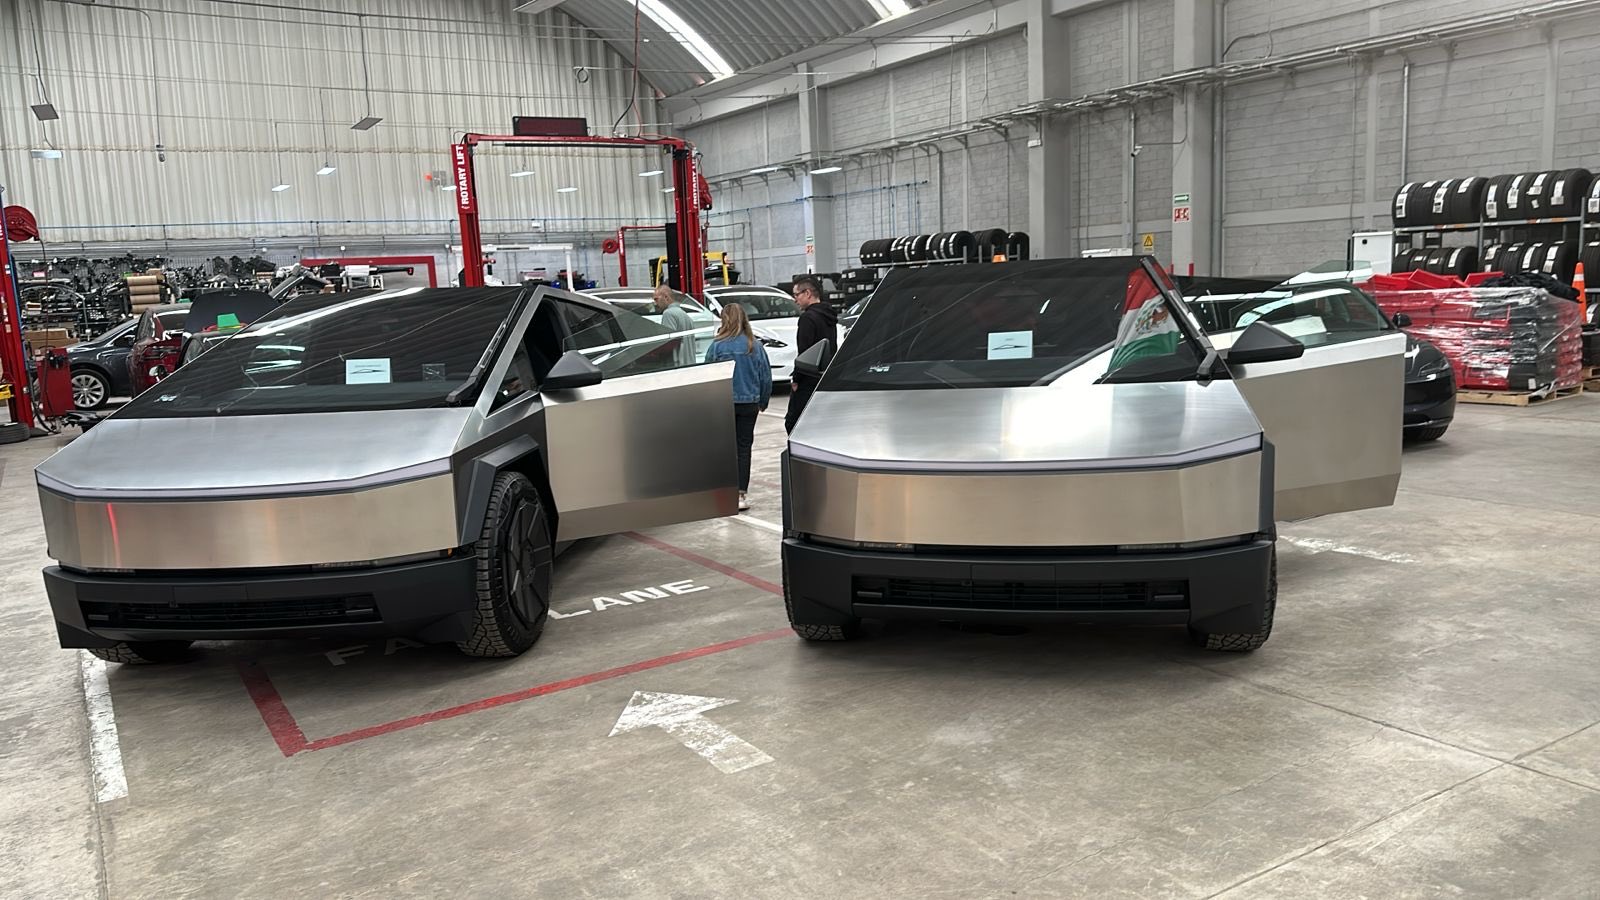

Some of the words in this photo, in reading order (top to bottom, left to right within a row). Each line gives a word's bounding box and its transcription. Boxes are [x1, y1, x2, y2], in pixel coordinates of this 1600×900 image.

[455, 145, 465, 165] LIFT
[457, 167, 469, 205] ROTARY
[549, 579, 709, 620] LANE
